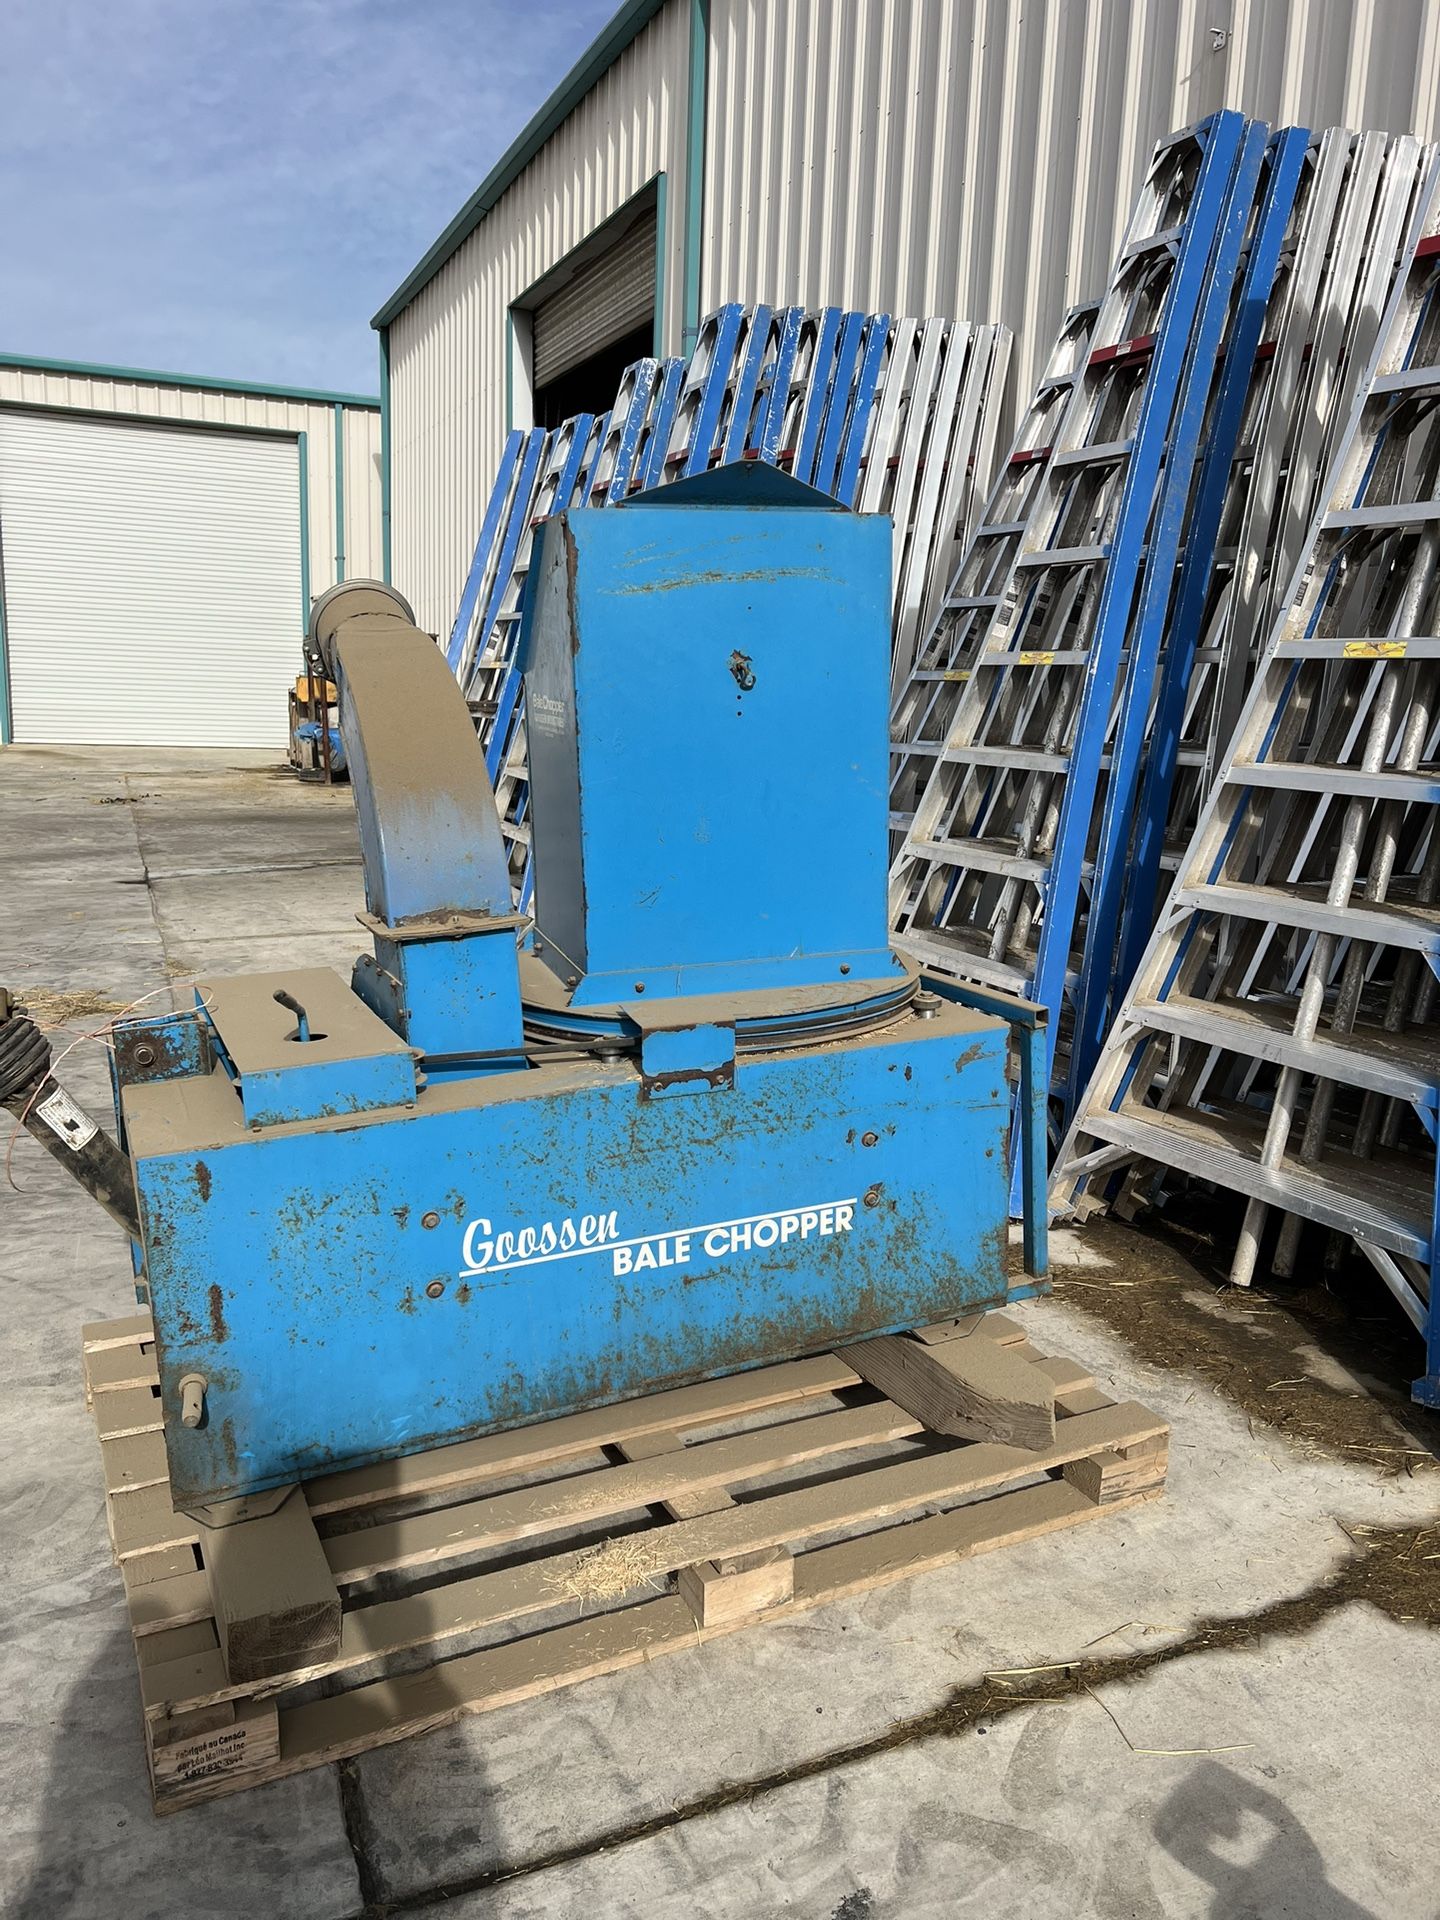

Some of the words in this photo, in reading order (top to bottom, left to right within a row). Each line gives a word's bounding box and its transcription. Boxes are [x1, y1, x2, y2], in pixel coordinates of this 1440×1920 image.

[462, 1210, 620, 1269] Goossen
[613, 1235, 690, 1276] BALE
[704, 1205, 853, 1258] CHOPPER
[218, 1731, 246, 1745] Canada
